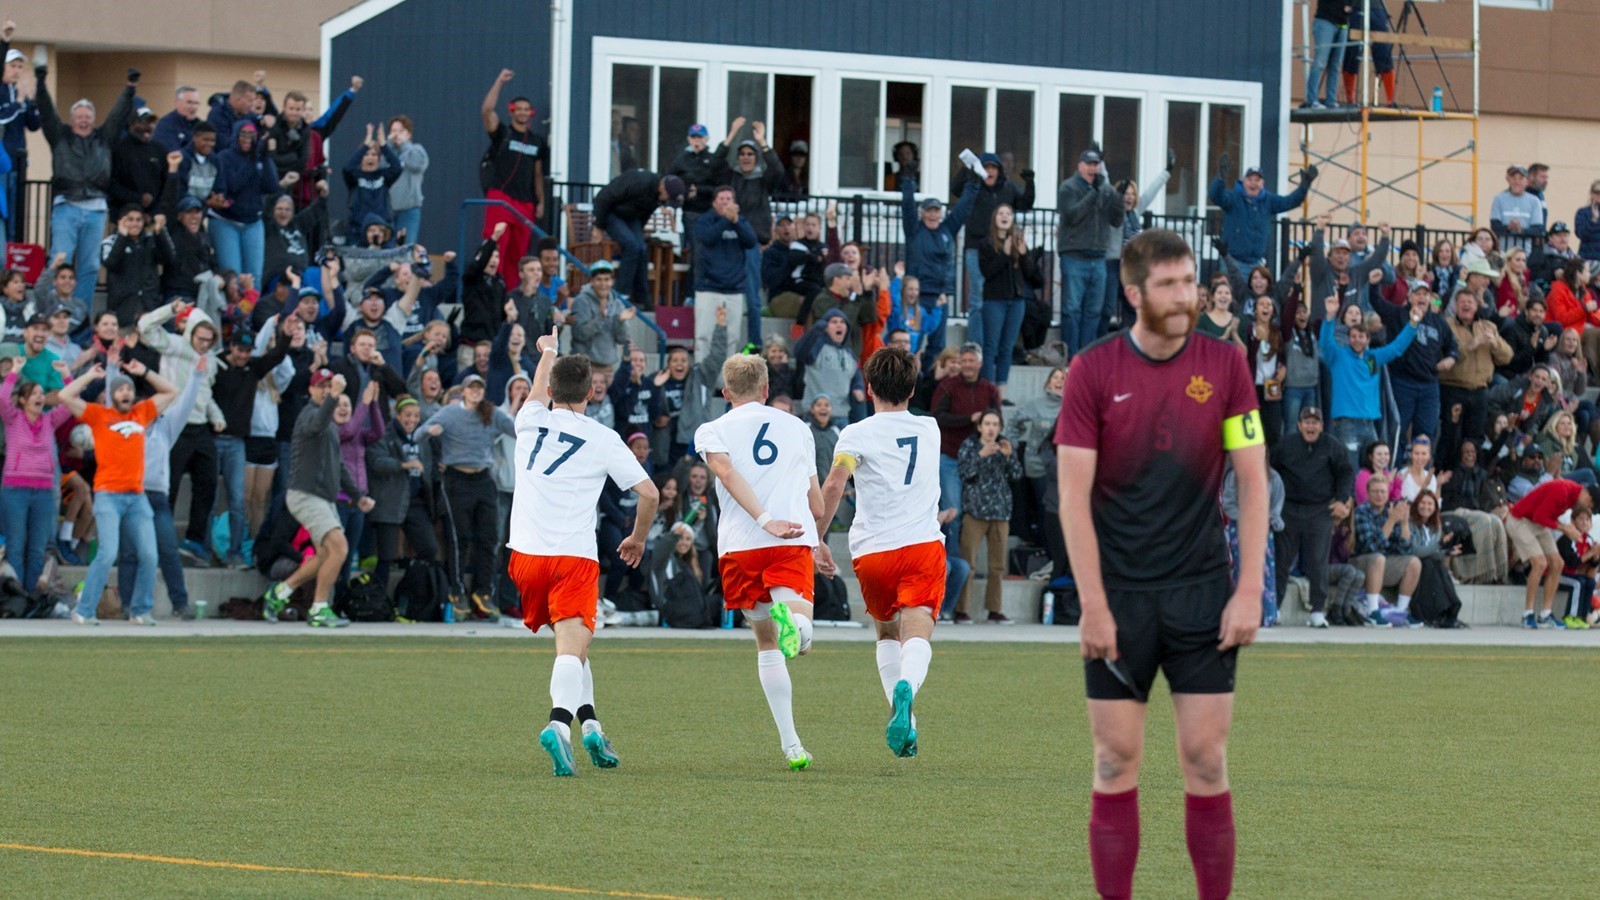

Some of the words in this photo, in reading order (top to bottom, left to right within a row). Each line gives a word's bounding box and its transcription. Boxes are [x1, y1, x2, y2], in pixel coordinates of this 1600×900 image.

[753, 423, 778, 465] 6
[1242, 413, 1255, 440] C
[526, 427, 587, 476] 17
[896, 436, 918, 485] 7
